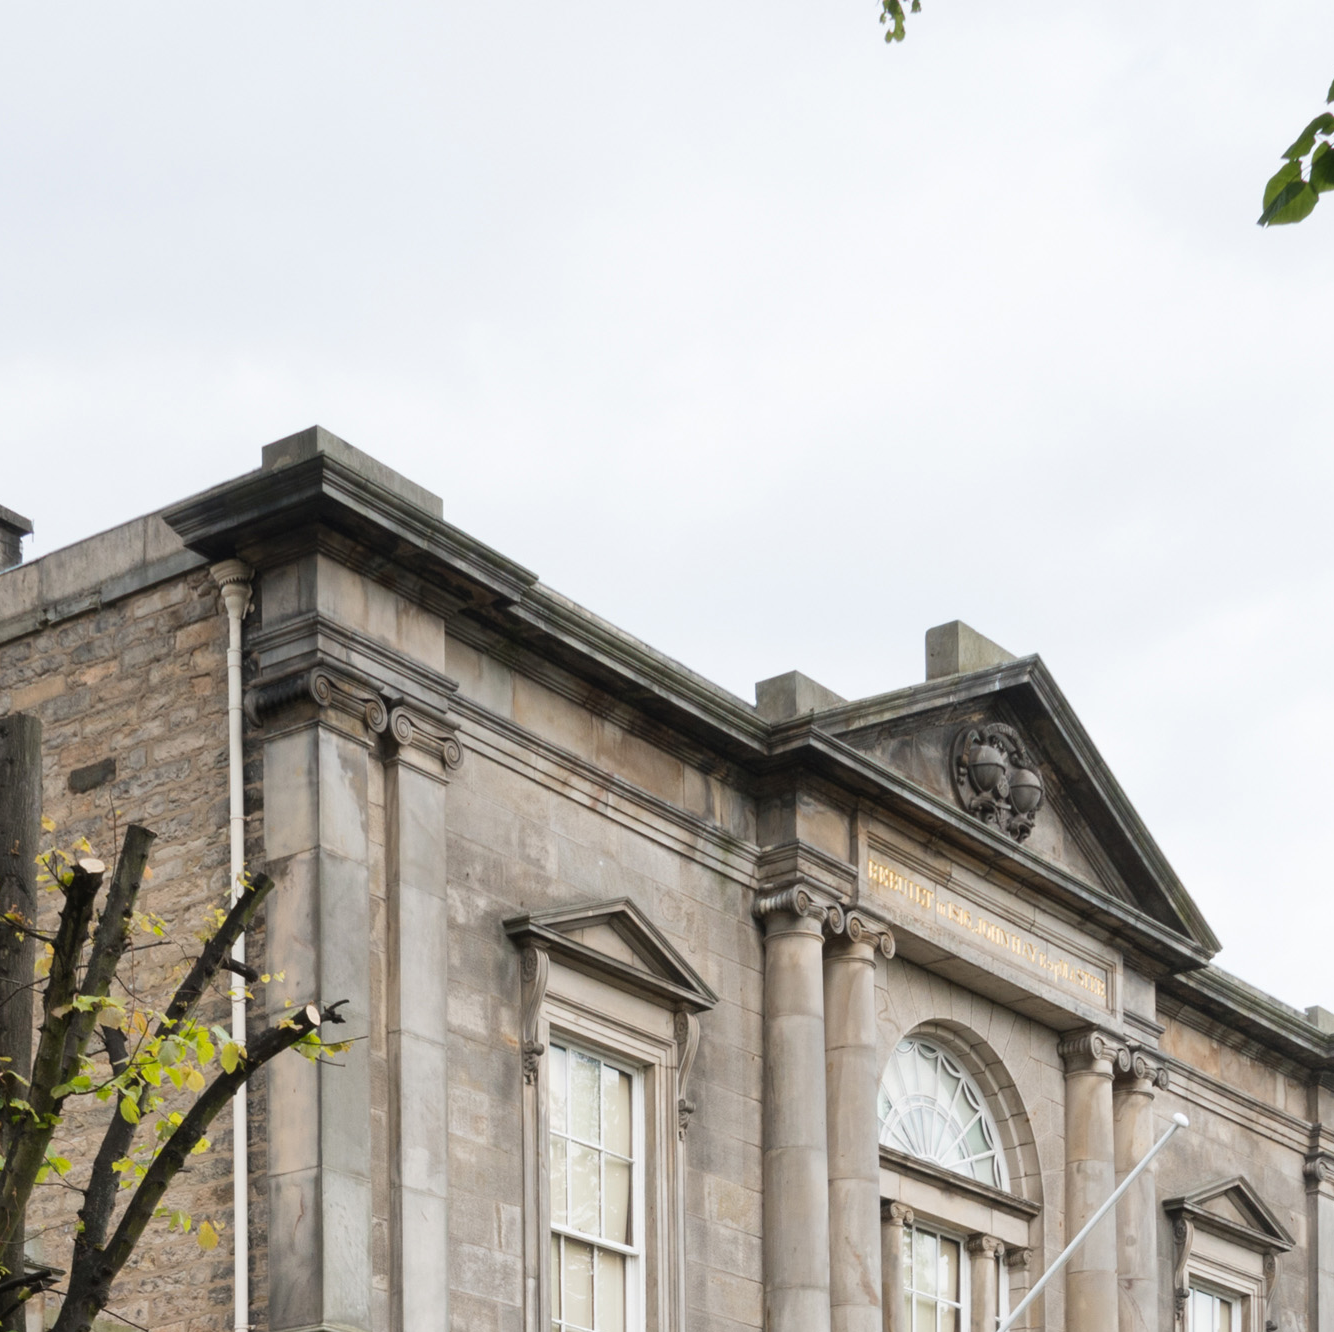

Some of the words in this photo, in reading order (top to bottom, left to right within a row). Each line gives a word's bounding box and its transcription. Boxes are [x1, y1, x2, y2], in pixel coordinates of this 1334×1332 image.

[868, 859, 934, 909] REBUILT
[975, 917, 1010, 949] JOHN
[1011, 934, 1039, 963] HAY
